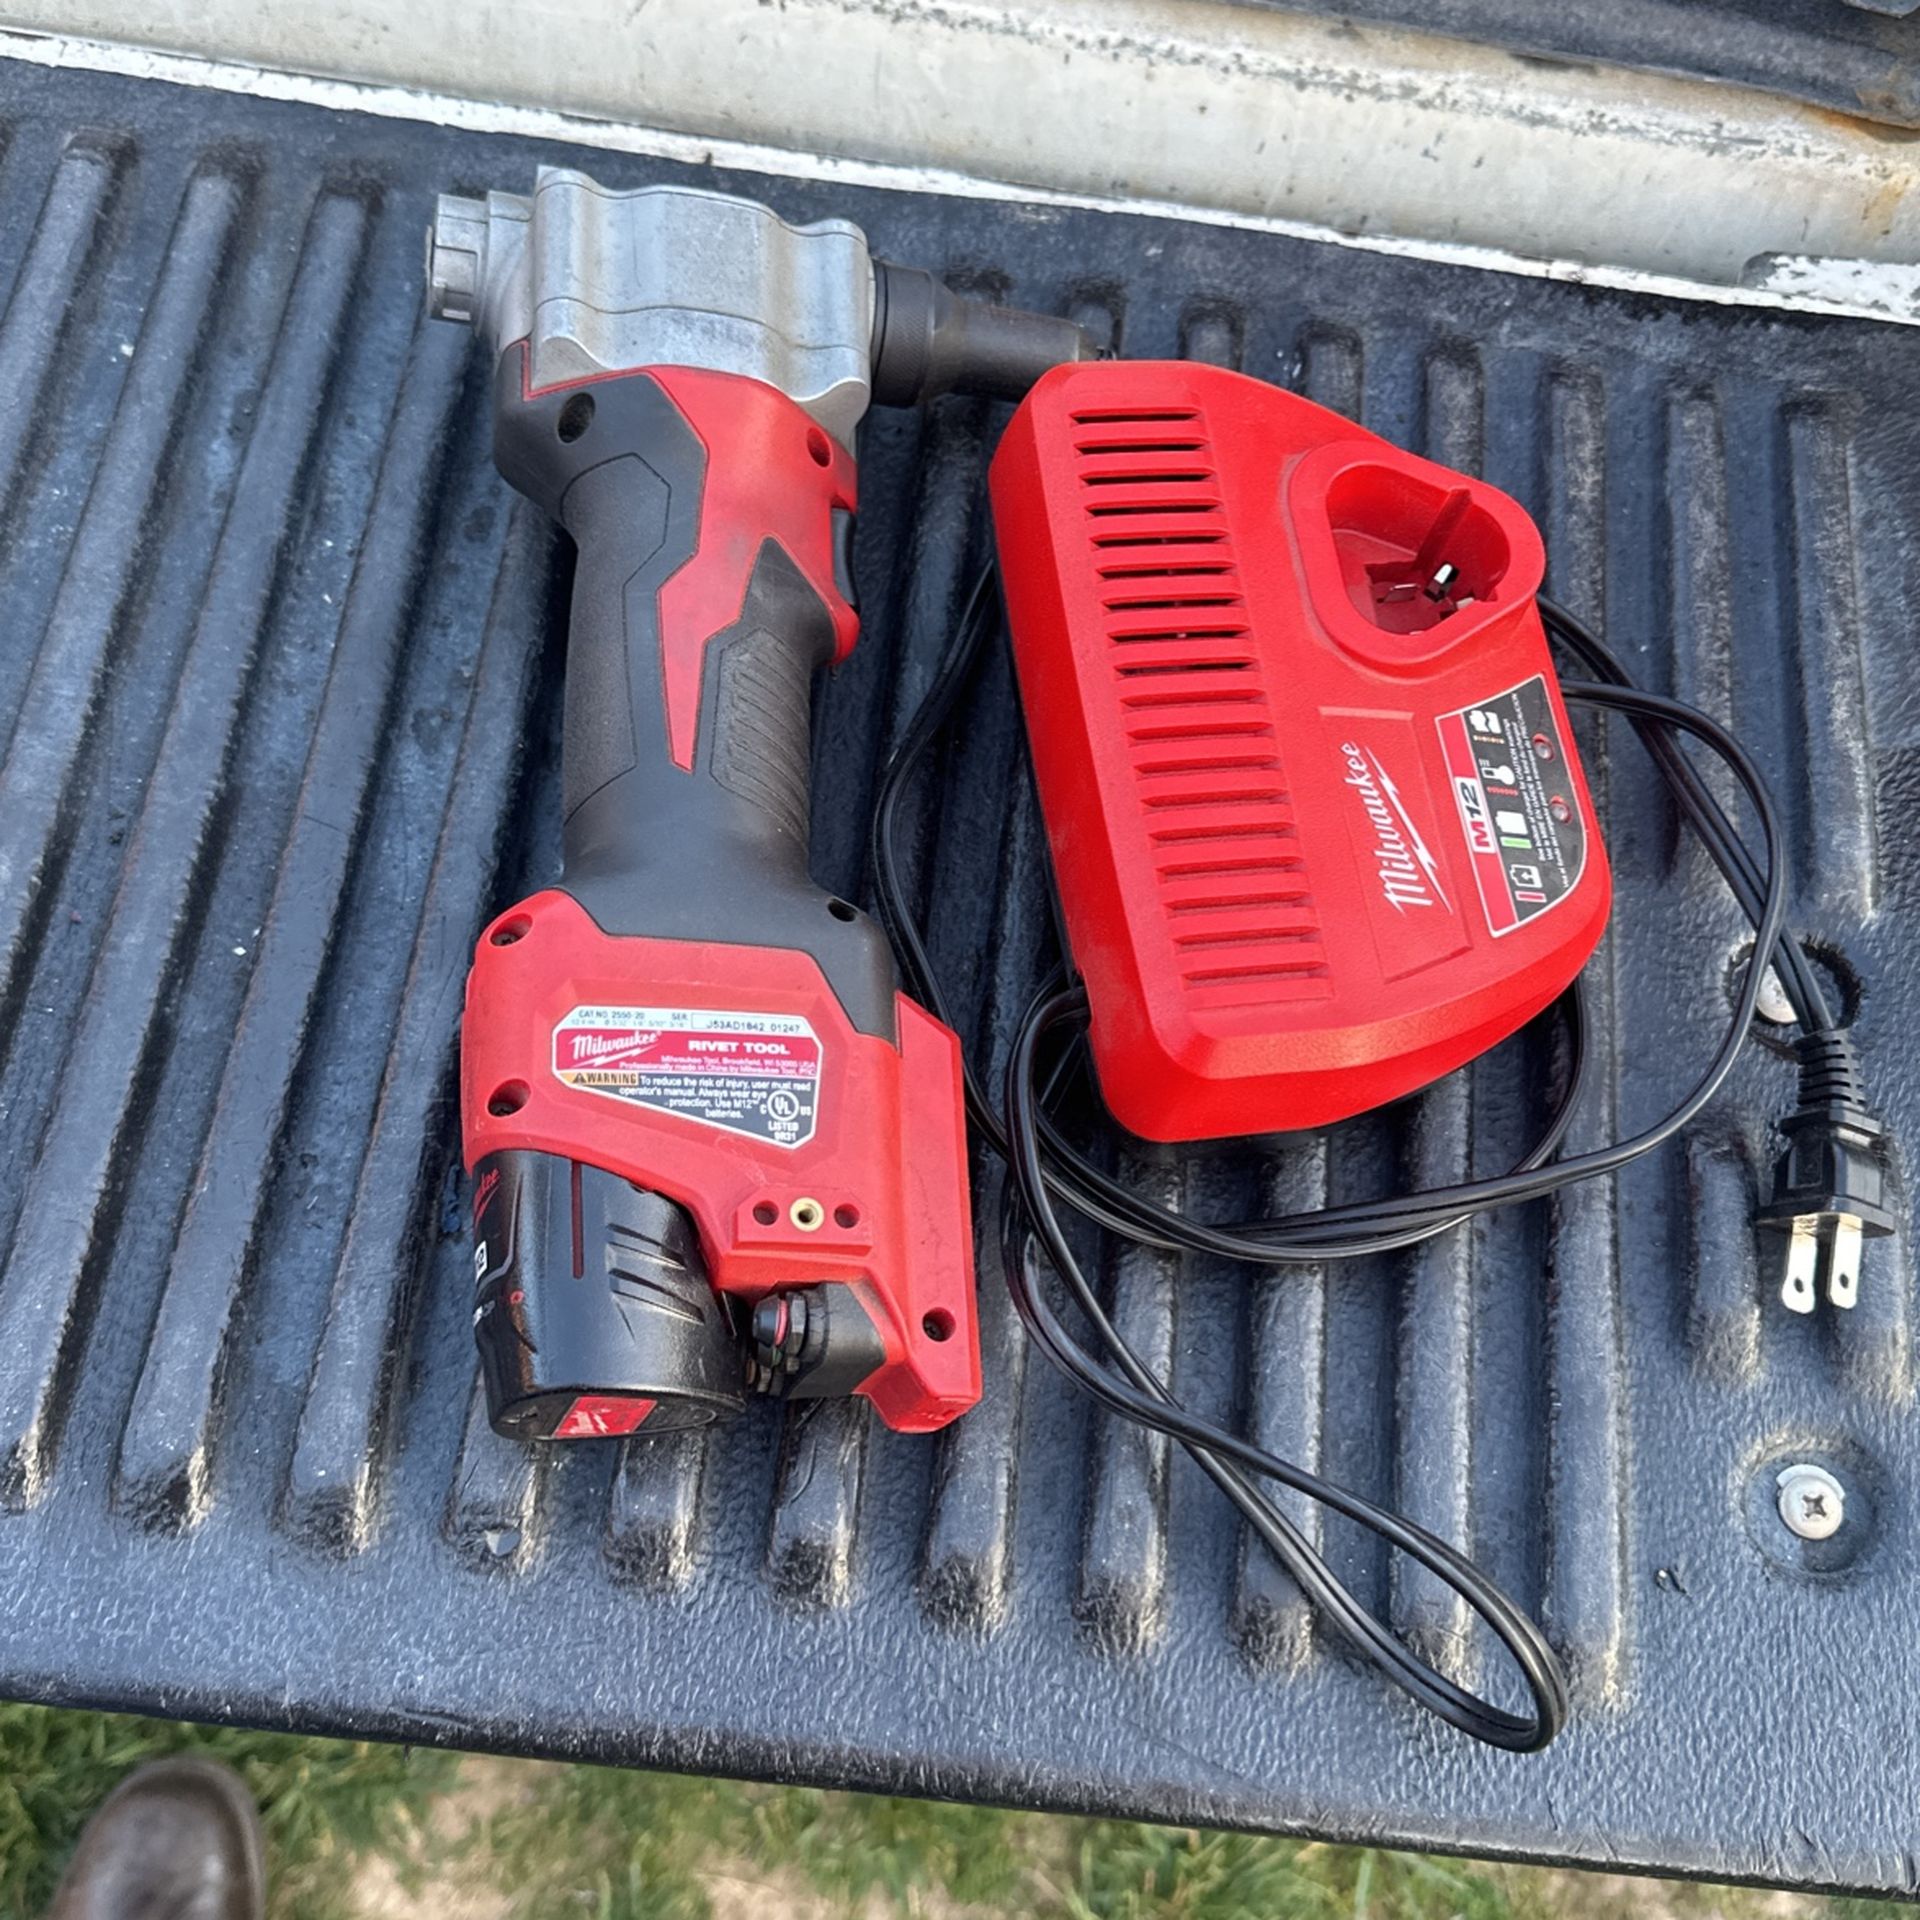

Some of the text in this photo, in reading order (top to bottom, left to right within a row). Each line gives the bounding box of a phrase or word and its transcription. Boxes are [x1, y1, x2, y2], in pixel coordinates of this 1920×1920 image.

[1509, 747, 1524, 780] CAUTION
[1459, 781, 1491, 848] M12
[1340, 740, 1434, 916] Milwaukee
[687, 1040, 791, 1056] RIVET TOOL
[586, 1072, 637, 1084] WARNING
[640, 1075, 651, 1086] To
[652, 1075, 682, 1086] reduce
[683, 1076, 697, 1087] the
[699, 1076, 714, 1087] risk
[715, 1077, 725, 1088] of
[751, 1080, 770, 1089] user
[771, 1081, 792, 1090] must
[793, 1081, 812, 1092] read
[618, 1086, 768, 1101] operator's manual. Always wear eye
[715, 1098, 732, 1109] Use
[800, 1105, 813, 1116] US
[767, 1120, 799, 1132] LISTED
